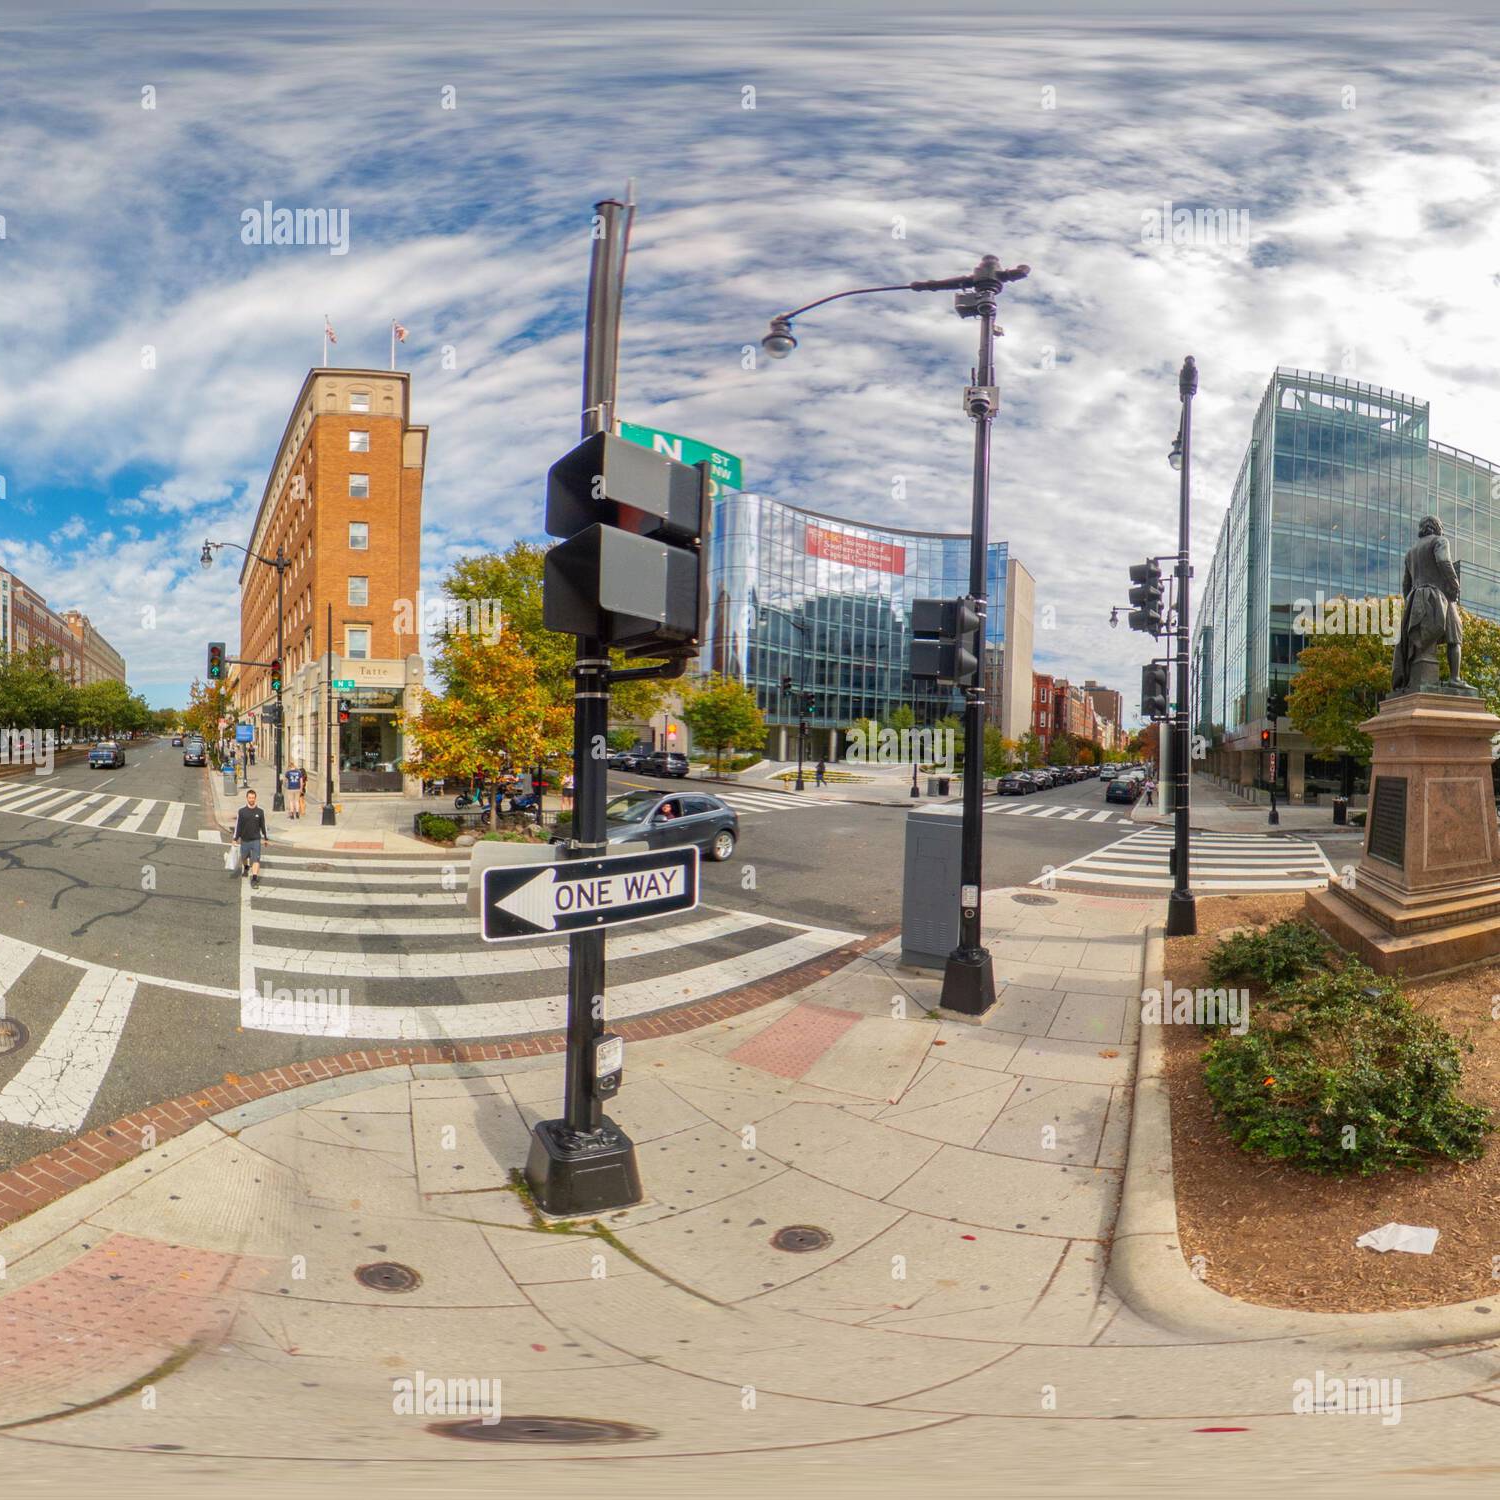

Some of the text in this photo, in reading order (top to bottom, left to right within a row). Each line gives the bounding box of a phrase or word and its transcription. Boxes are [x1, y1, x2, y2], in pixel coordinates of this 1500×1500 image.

[653, 433, 730, 467] N ST
[712, 464, 732, 480] NW
[359, 666, 388, 676] Tatte
[555, 870, 677, 911] ONE WAY
